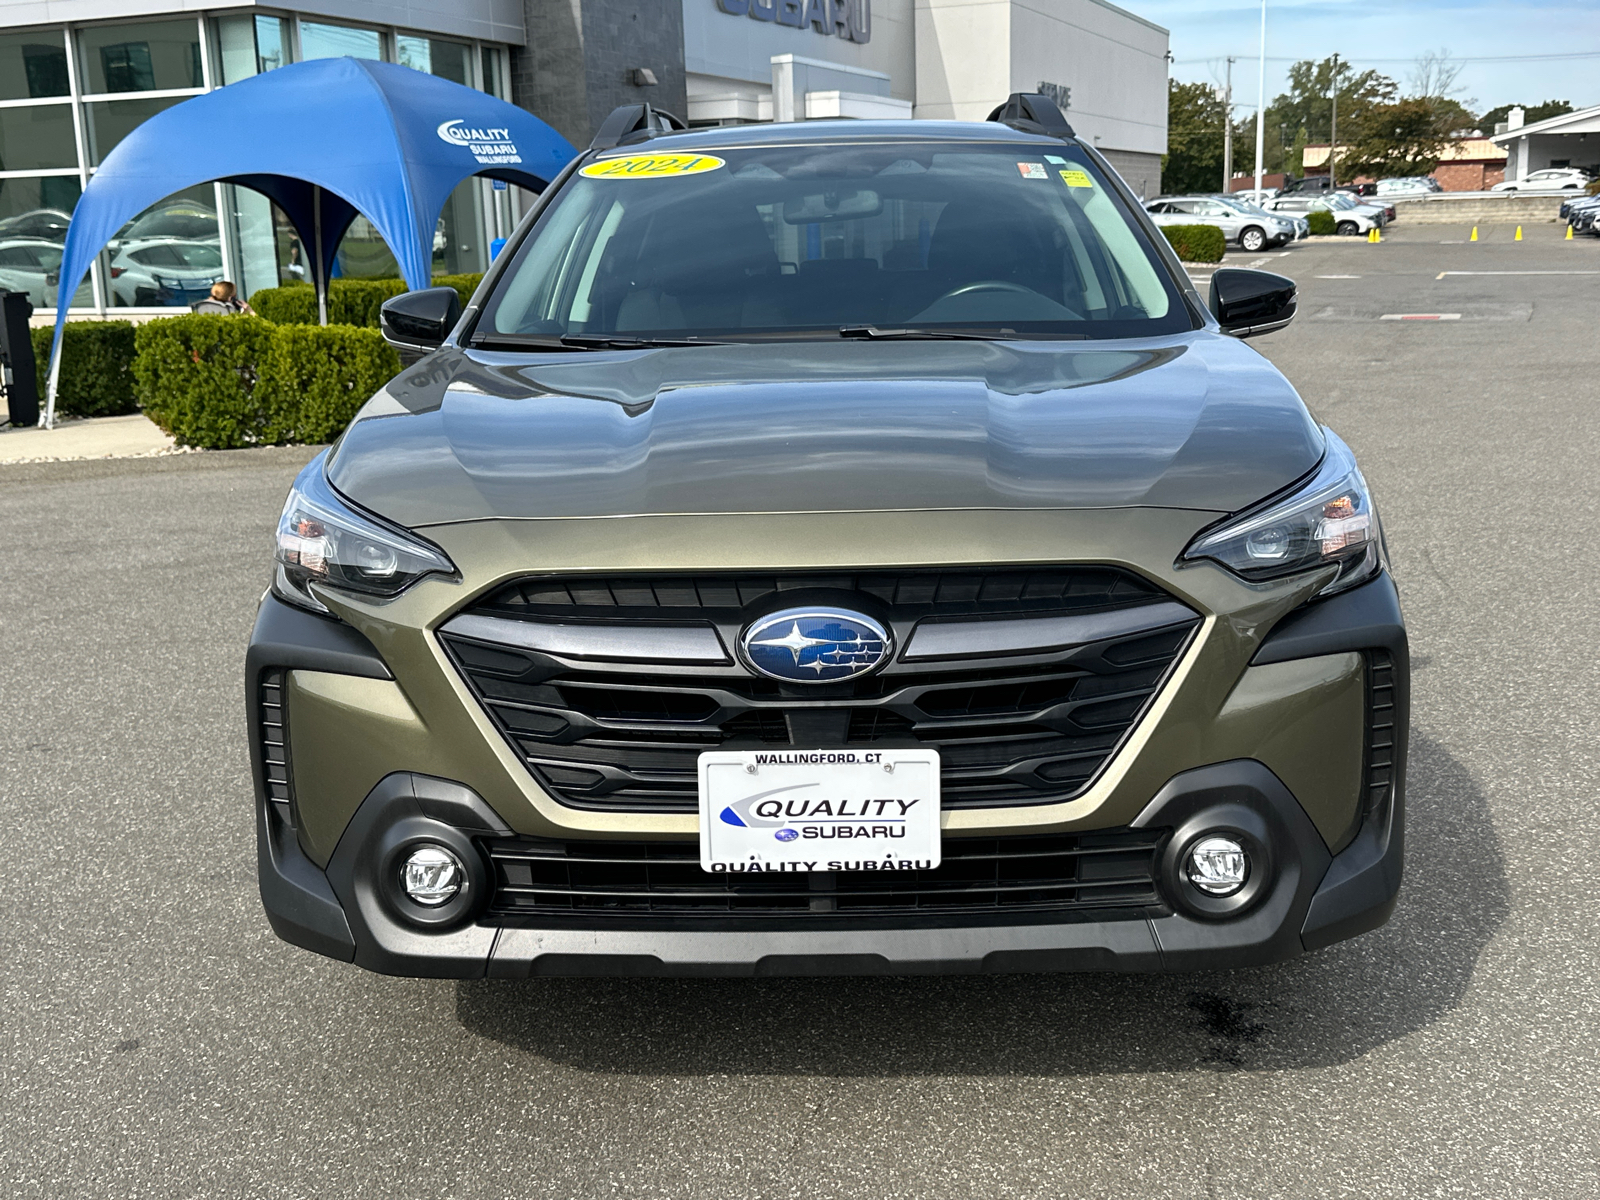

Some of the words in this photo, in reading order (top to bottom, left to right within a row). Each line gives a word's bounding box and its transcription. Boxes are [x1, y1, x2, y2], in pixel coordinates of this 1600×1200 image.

[447, 127, 509, 141] QUALITY
[469, 144, 517, 155] SUBARU
[474, 155, 522, 164] WALLINGFORD
[600, 158, 703, 175] 2024
[865, 753, 882, 763] CT
[755, 799, 920, 818] QUALITY
[802, 826, 906, 839] SUBARU
[710, 862, 818, 873] QUALITY
[827, 860, 931, 871] SUBARU
